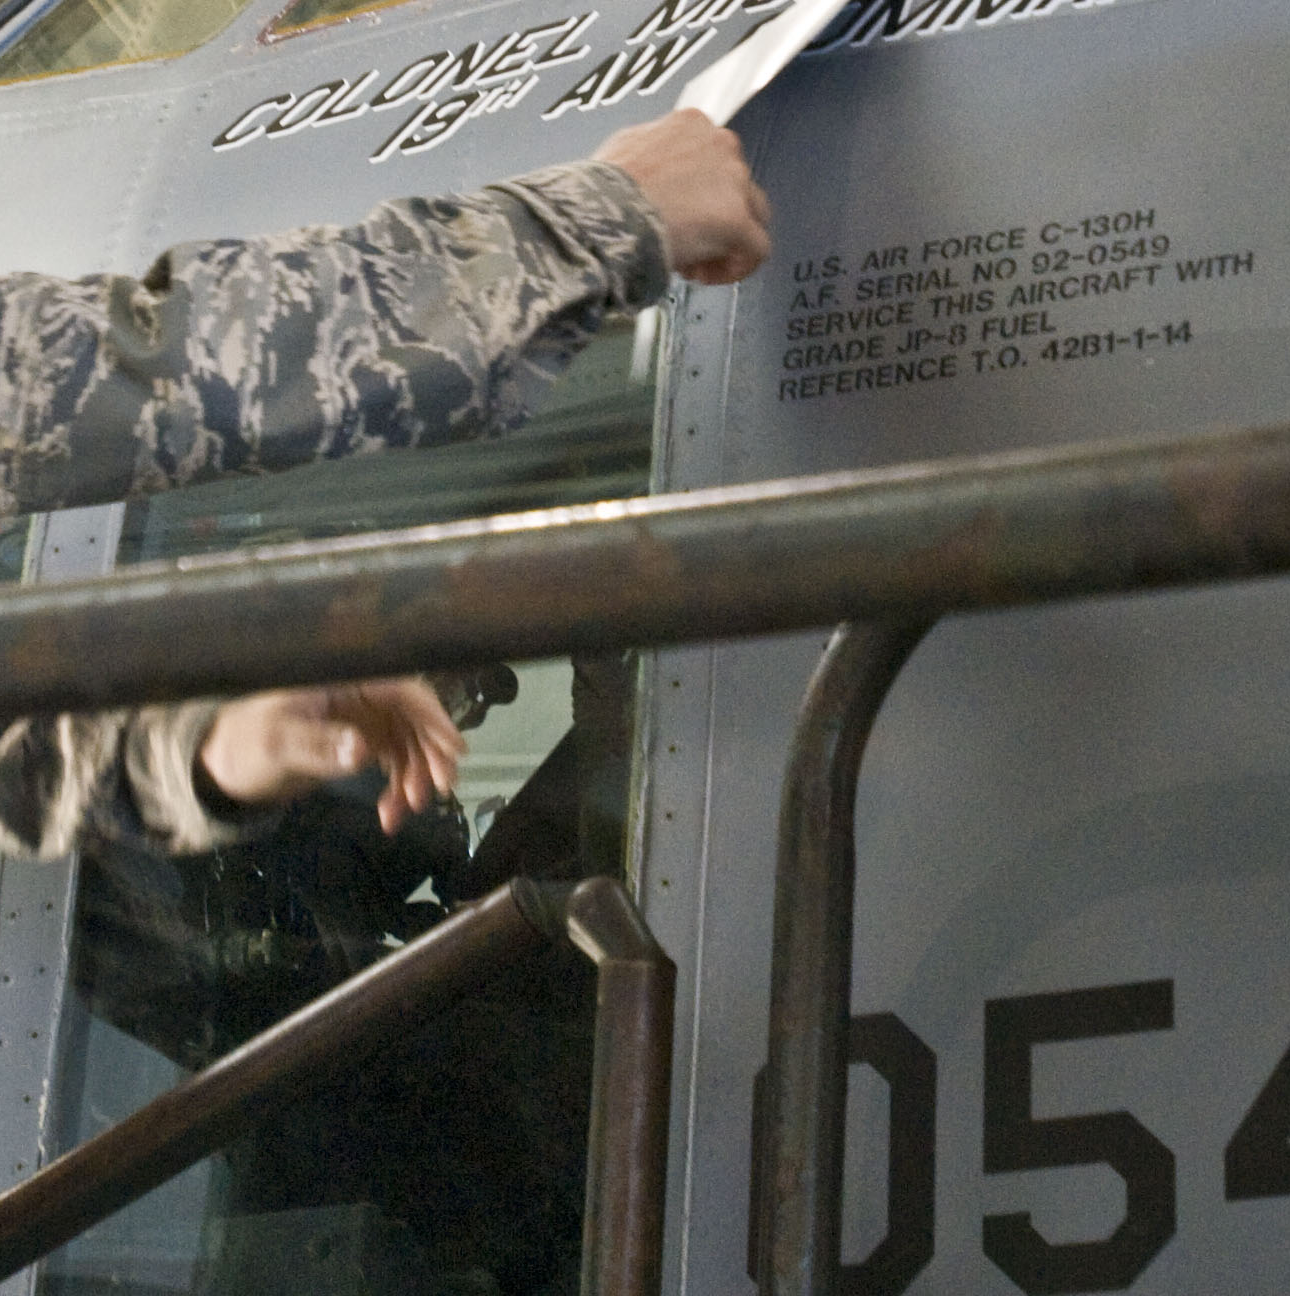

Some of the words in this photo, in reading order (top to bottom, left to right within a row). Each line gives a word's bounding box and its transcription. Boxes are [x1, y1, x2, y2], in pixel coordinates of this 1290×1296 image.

[212, 10, 600, 153] COLONEL
[541, 27, 717, 120] AW
[790, 283, 840, 312] A.F.
[856, 268, 960, 302] SERIAL
[972, 258, 1018, 283] NO
[1031, 235, 1171, 275] 92-0549
[794, 256, 847, 282] U.S.
[860, 247, 909, 272] AIR
[922, 227, 1027, 263] FORCE
[1040, 209, 1155, 244] C-130H
[786, 301, 914, 342] SERVICE
[930, 290, 995, 318] THIS
[1007, 264, 1161, 307] AIRCRAFT
[1175, 252, 1255, 282] WITH
[778, 354, 959, 402] REFERENCE
[972, 346, 1028, 374] T.O.
[1040, 320, 1194, 363] 42B1-1-14
[782, 335, 886, 371] GRADE
[896, 323, 968, 354] JP-8
[981, 310, 1058, 341] FUEL
